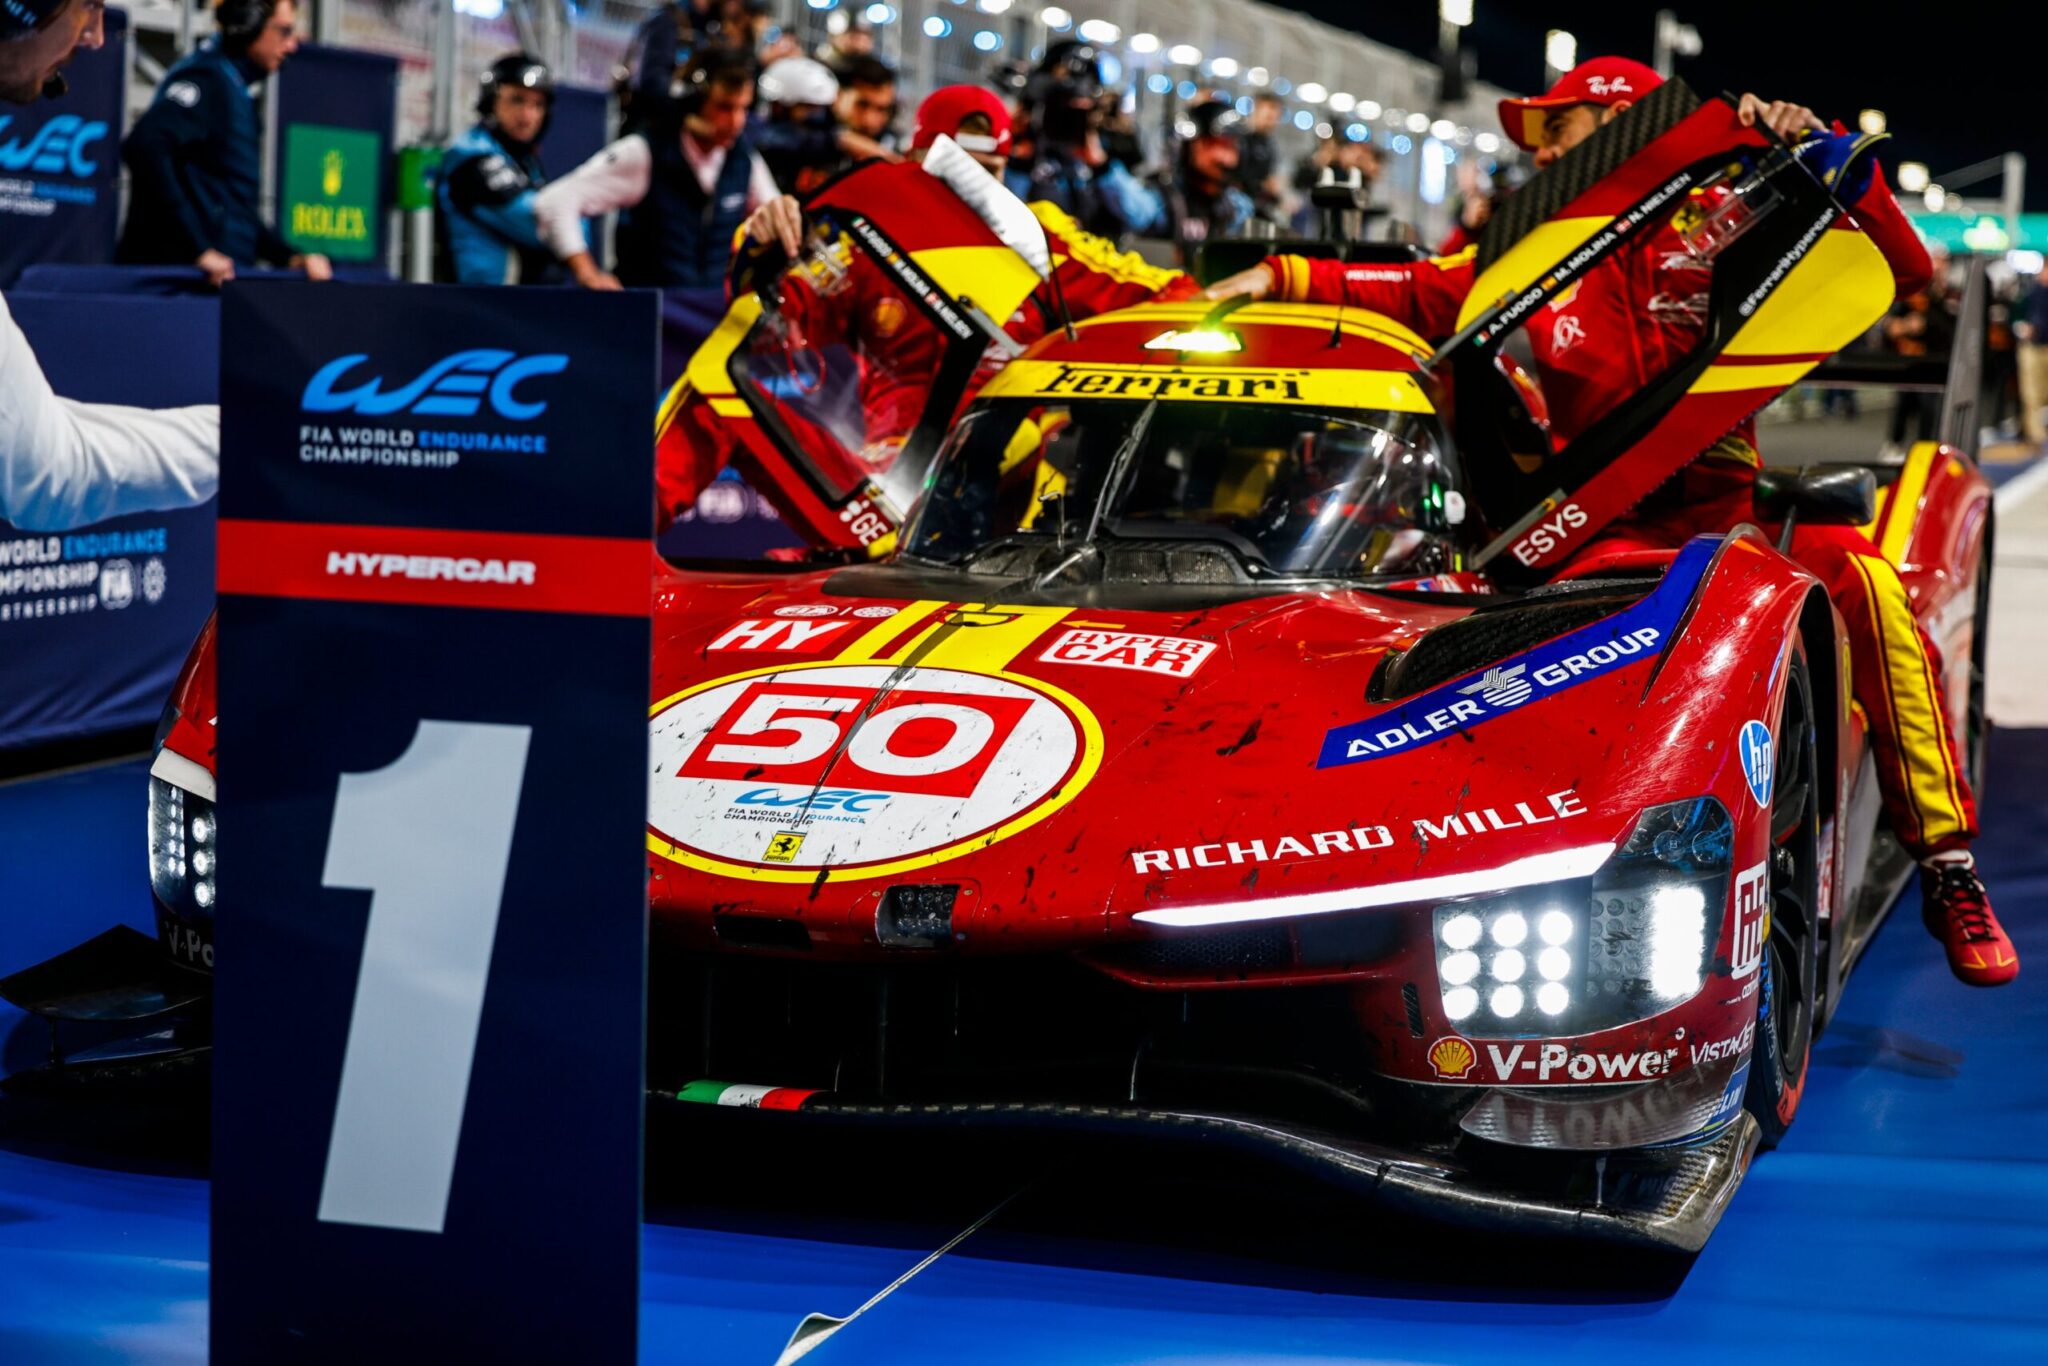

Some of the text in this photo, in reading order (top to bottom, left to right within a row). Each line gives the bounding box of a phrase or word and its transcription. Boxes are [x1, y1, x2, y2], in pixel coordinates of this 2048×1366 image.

[292, 203, 367, 239] ROLEX
[301, 348, 570, 420] WEC
[1036, 364, 1311, 401] Ferrari
[300, 426, 547, 453] FIA WORLD ENDURANCE
[300, 444, 460, 468] CHAMPIONSHIP
[63, 527, 168, 560] ENDURANCE
[1512, 503, 1588, 567] ESYS
[326, 551, 536, 585] HYPERCAR
[706, 620, 851, 650] HY
[1069, 632, 1205, 654] HYPER
[1053, 643, 1192, 673] CAR
[1346, 627, 1661, 758] ADLER GROUP
[705, 693, 996, 777] 50
[1746, 721, 1771, 806] hp
[727, 807, 746, 815] FIA
[750, 808, 791, 818] WORLD
[734, 788, 892, 813] WEC
[724, 813, 814, 826] CHAMPIONSHIP
[1131, 789, 1588, 874] RICHARD MILLE
[317, 719, 533, 1235] 1
[1487, 1044, 1678, 1081] V-Power
